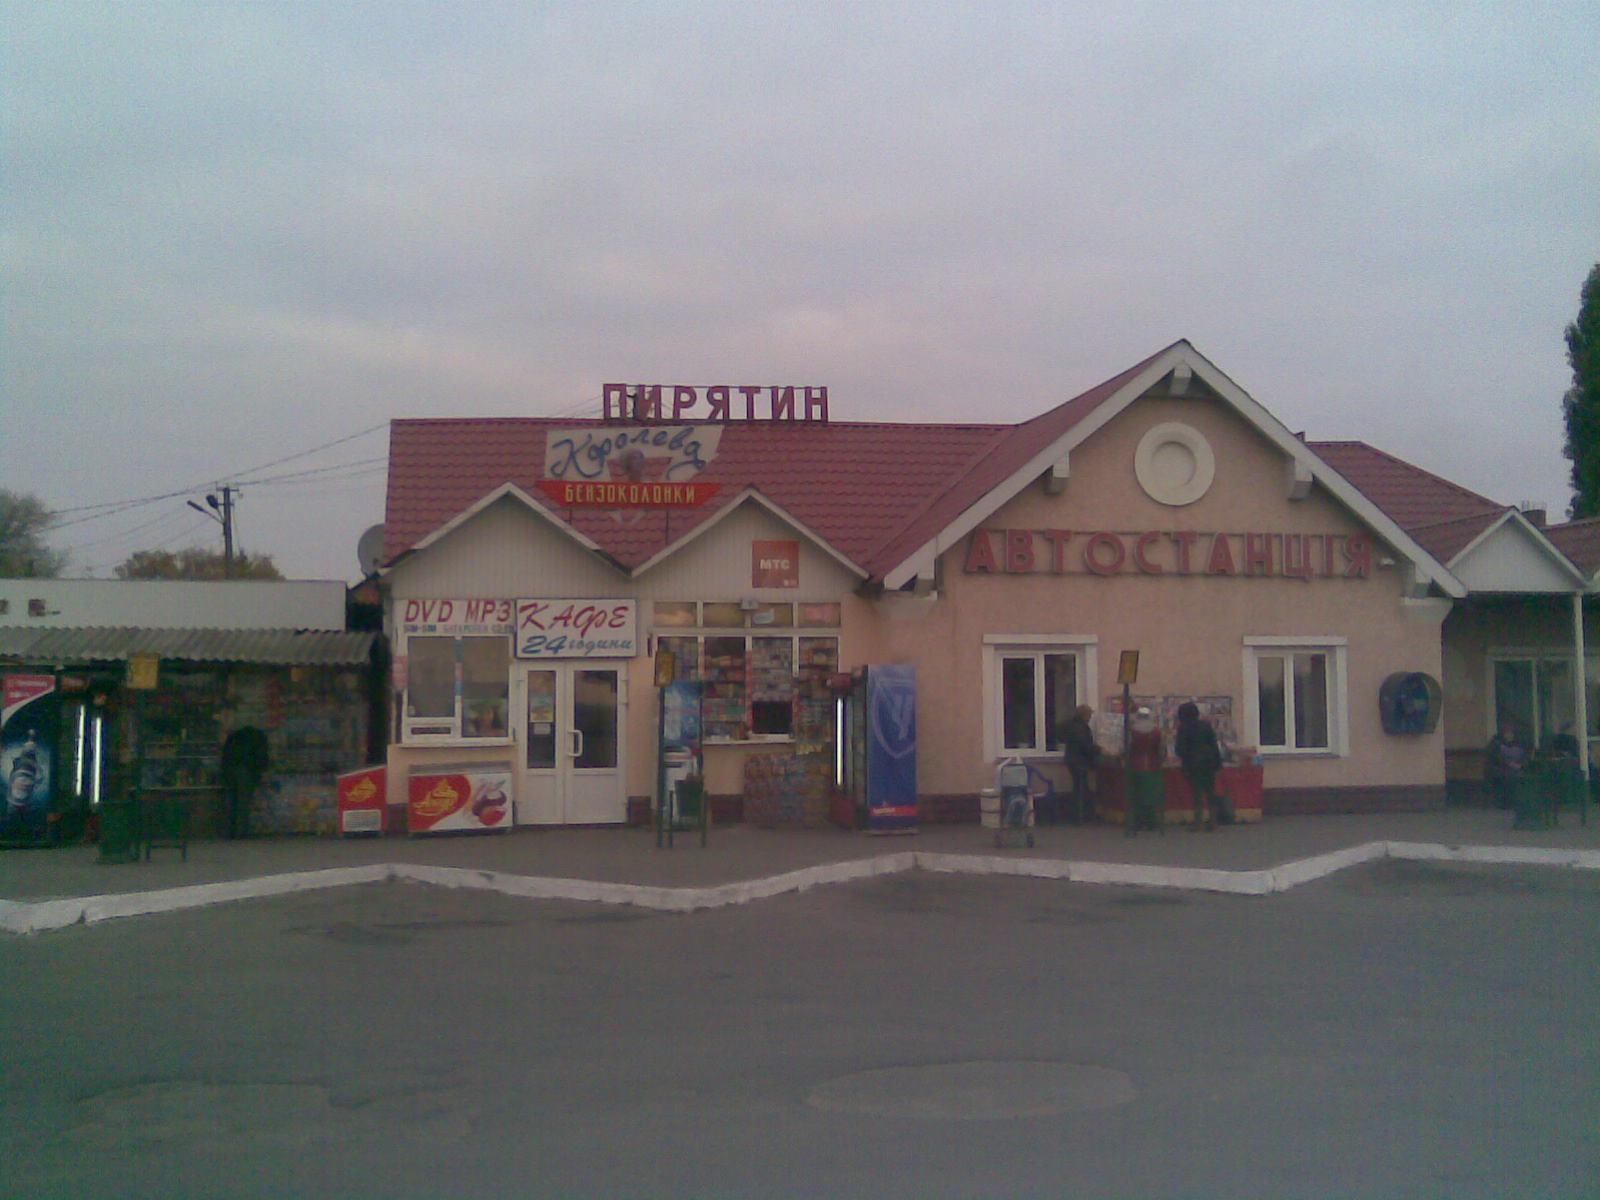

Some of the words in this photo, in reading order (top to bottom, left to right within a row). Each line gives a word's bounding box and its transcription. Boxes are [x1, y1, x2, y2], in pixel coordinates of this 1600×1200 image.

[602, 383, 829, 422] ПИРЯТИН
[550, 426, 705, 480] Королева
[565, 484, 696, 504] БЕНЗОКОЛОНКИ
[759, 558, 791, 570] МТС
[964, 527, 1373, 582] АВТОСТАНЦІЯ
[404, 600, 454, 623] DVD
[464, 599, 512, 623] MP3
[519, 602, 630, 638] КАФЕ
[521, 635, 568, 654] 24
